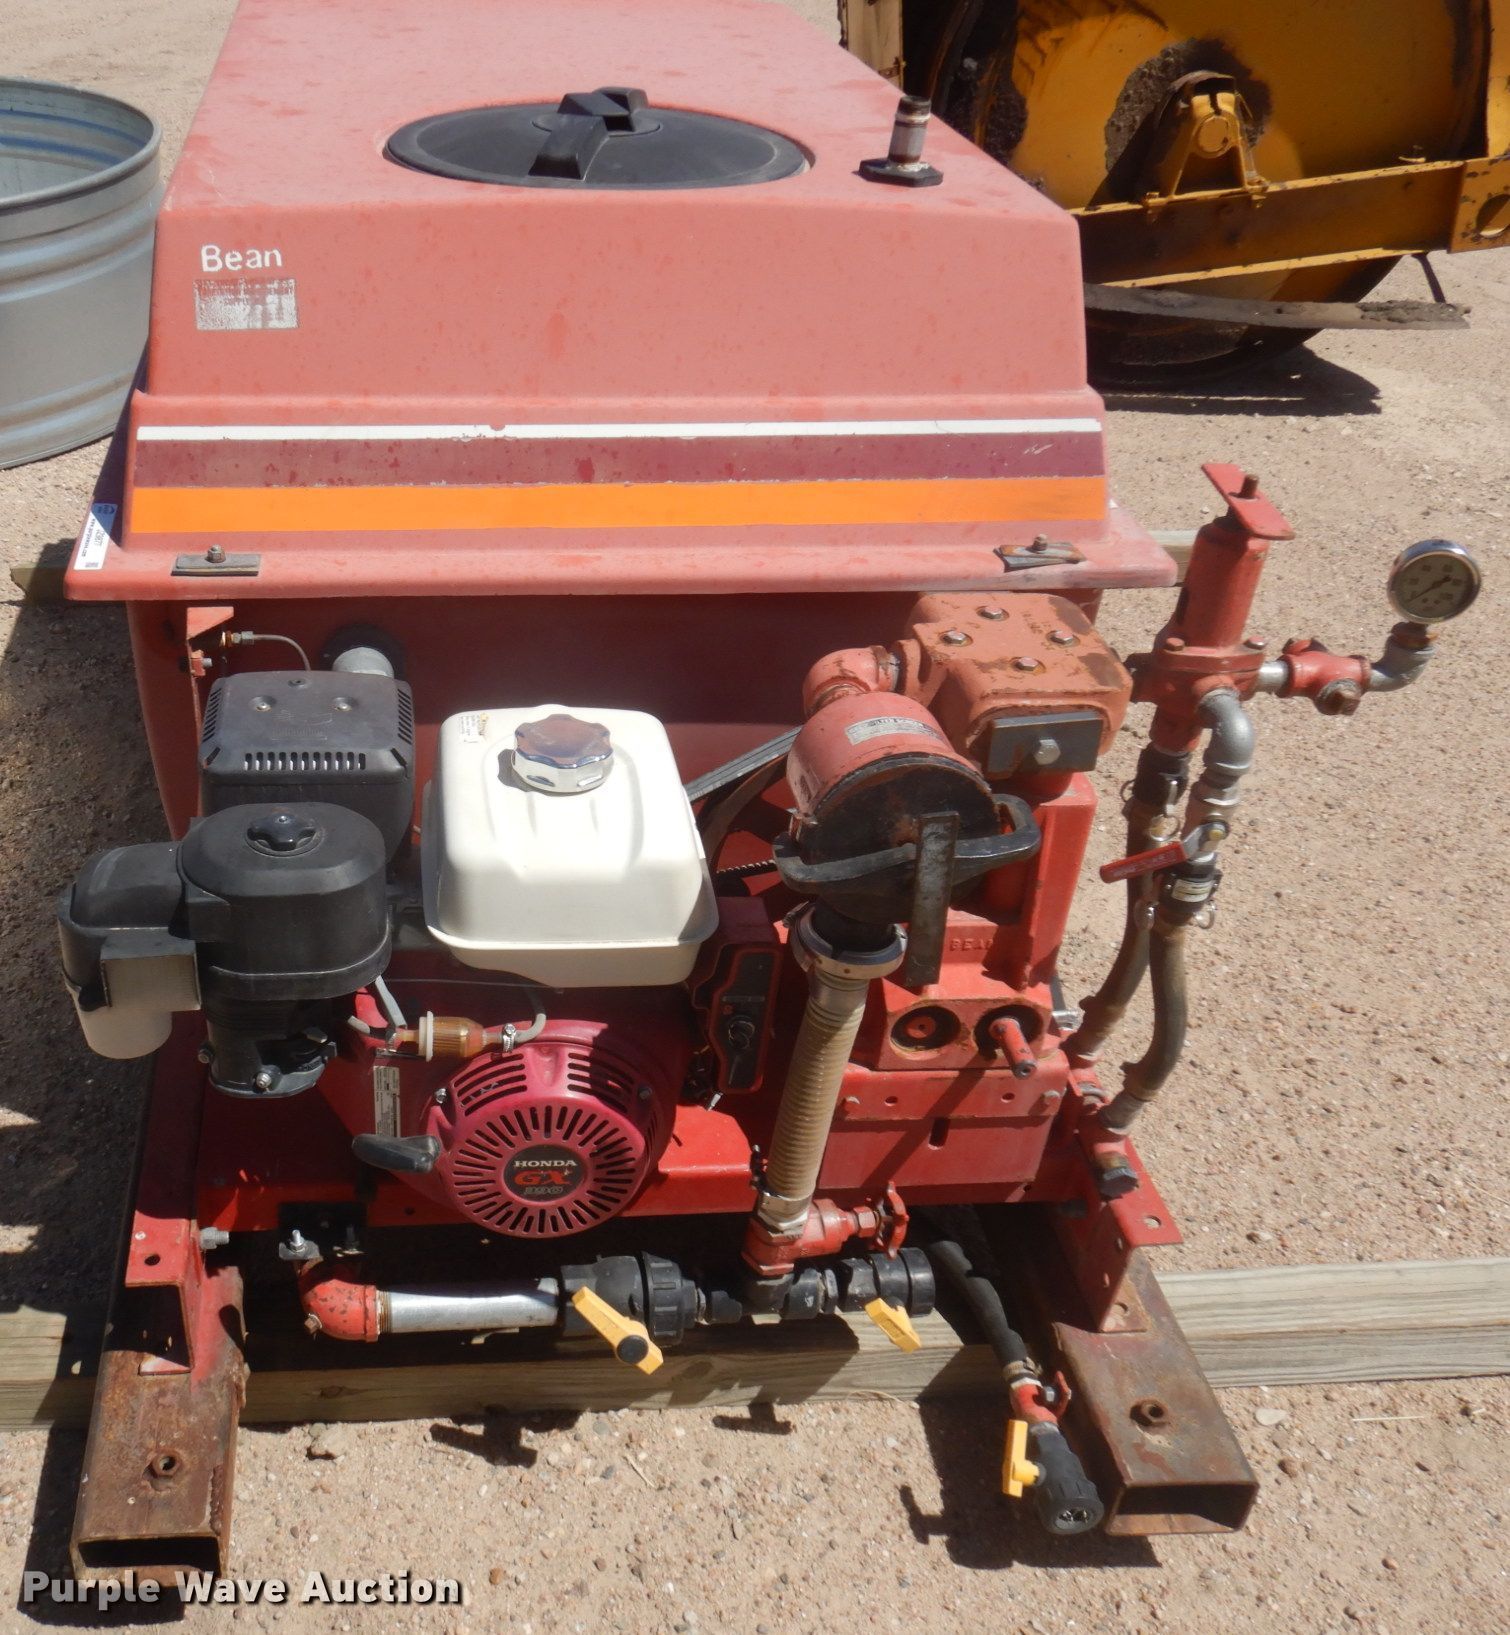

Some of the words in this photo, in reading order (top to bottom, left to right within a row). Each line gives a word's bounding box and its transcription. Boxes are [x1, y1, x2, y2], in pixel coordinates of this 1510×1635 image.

[201, 244, 283, 273] Bean
[514, 1160, 577, 1168] HONDA
[514, 1169, 571, 1185] GX
